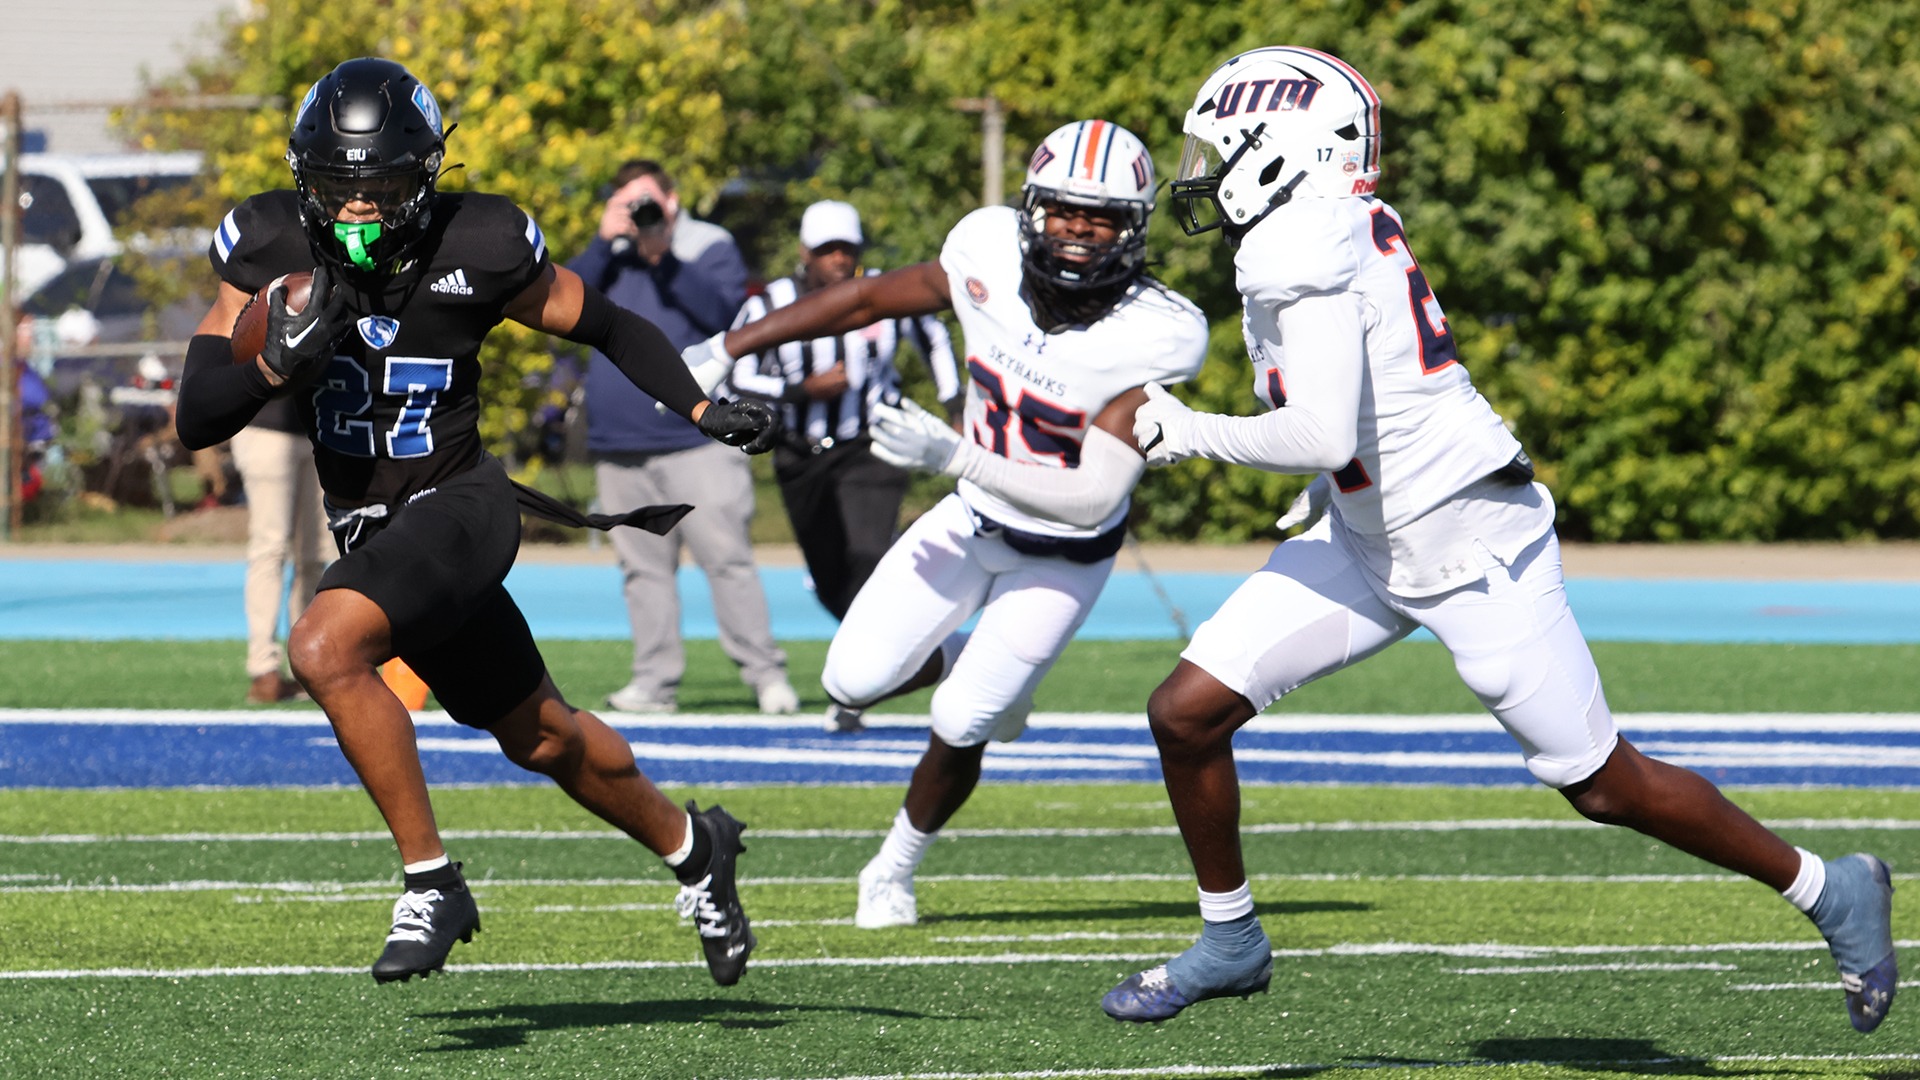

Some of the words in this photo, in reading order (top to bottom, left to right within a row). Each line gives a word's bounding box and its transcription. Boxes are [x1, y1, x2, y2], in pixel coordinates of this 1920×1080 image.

[1215, 78, 1322, 119] UTM
[346, 147, 367, 162] EIU
[1317, 147, 1334, 162] 17
[430, 282, 474, 296] adidas
[989, 344, 1067, 397] SKYHAWKS
[312, 355, 454, 459] 27
[966, 354, 1087, 470] 35
